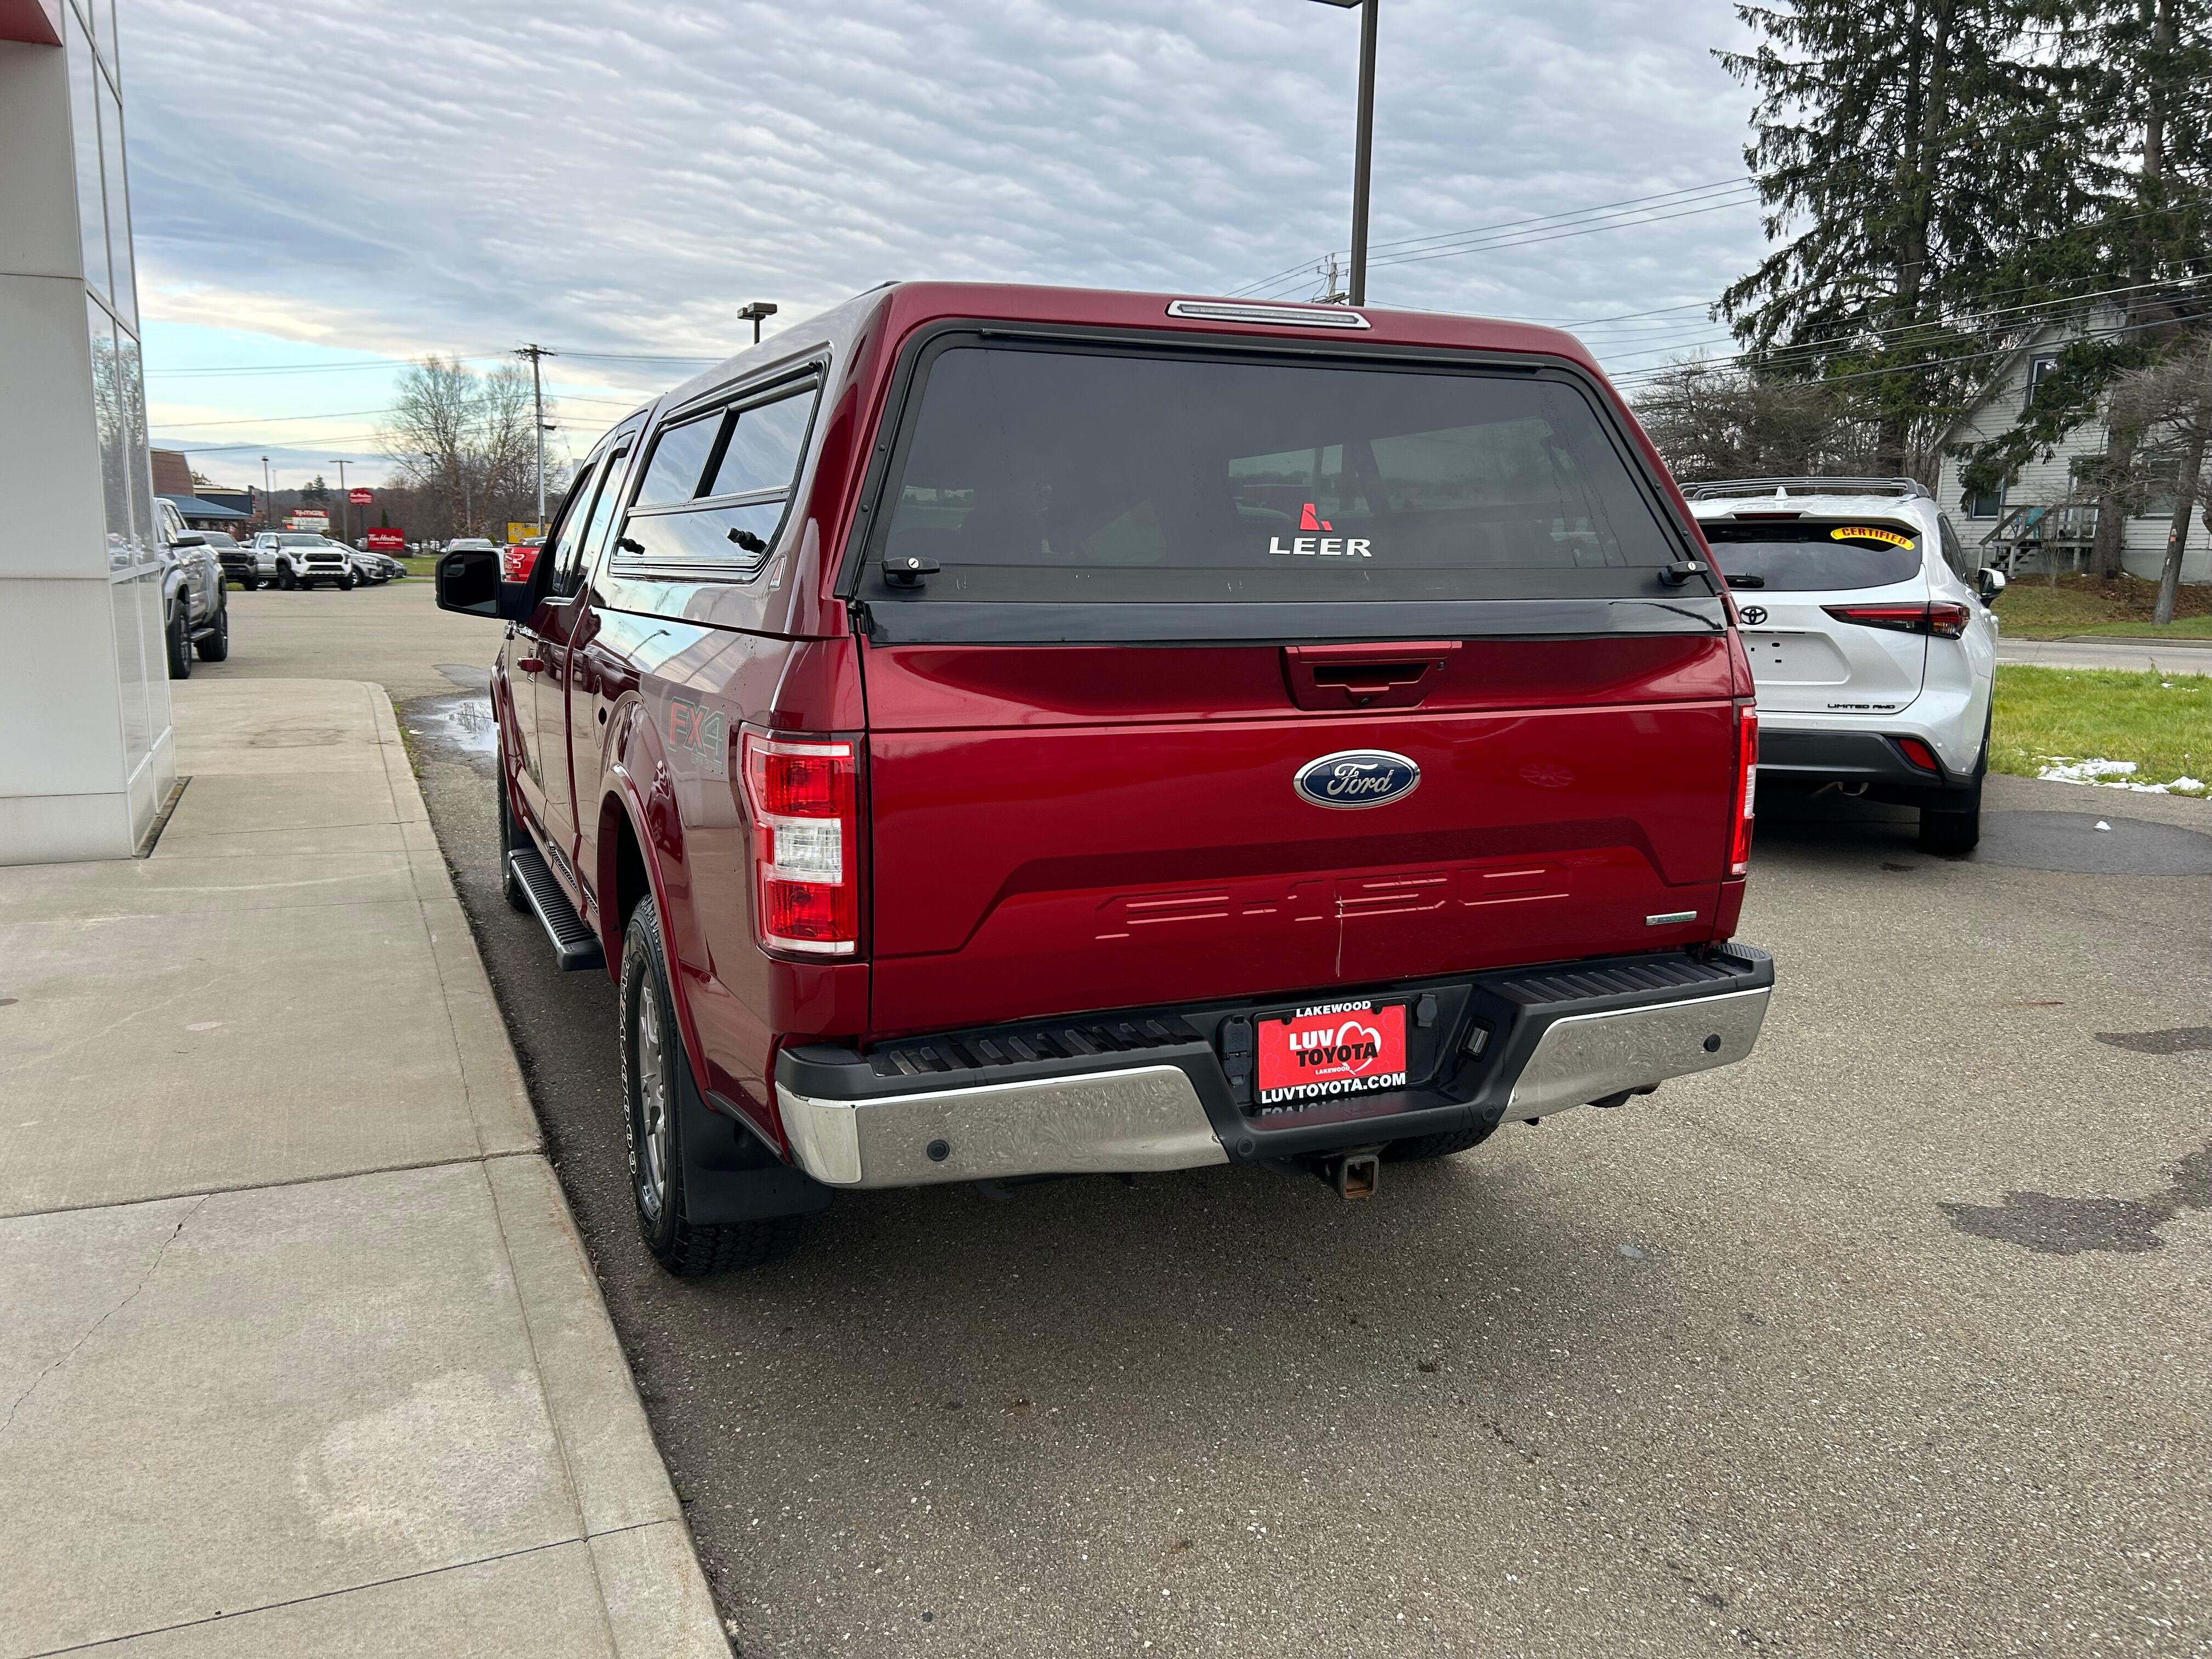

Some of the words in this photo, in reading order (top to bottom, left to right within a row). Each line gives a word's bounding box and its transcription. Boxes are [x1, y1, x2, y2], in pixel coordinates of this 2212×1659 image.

[1268, 536, 1373, 557] LEER
[1841, 527, 1907, 545] CERTIFIED
[667, 696, 725, 765] FX4
[1327, 763, 1395, 795] Ford
[1296, 1000, 1371, 1018] LAKEWOOD
[1289, 1028, 1334, 1051] LUV
[1296, 1042, 1378, 1067] TOYOTA
[1314, 1065, 1351, 1075] LAKEWOOD
[1261, 1072, 1406, 1104] LUVTOYOTA.COM
